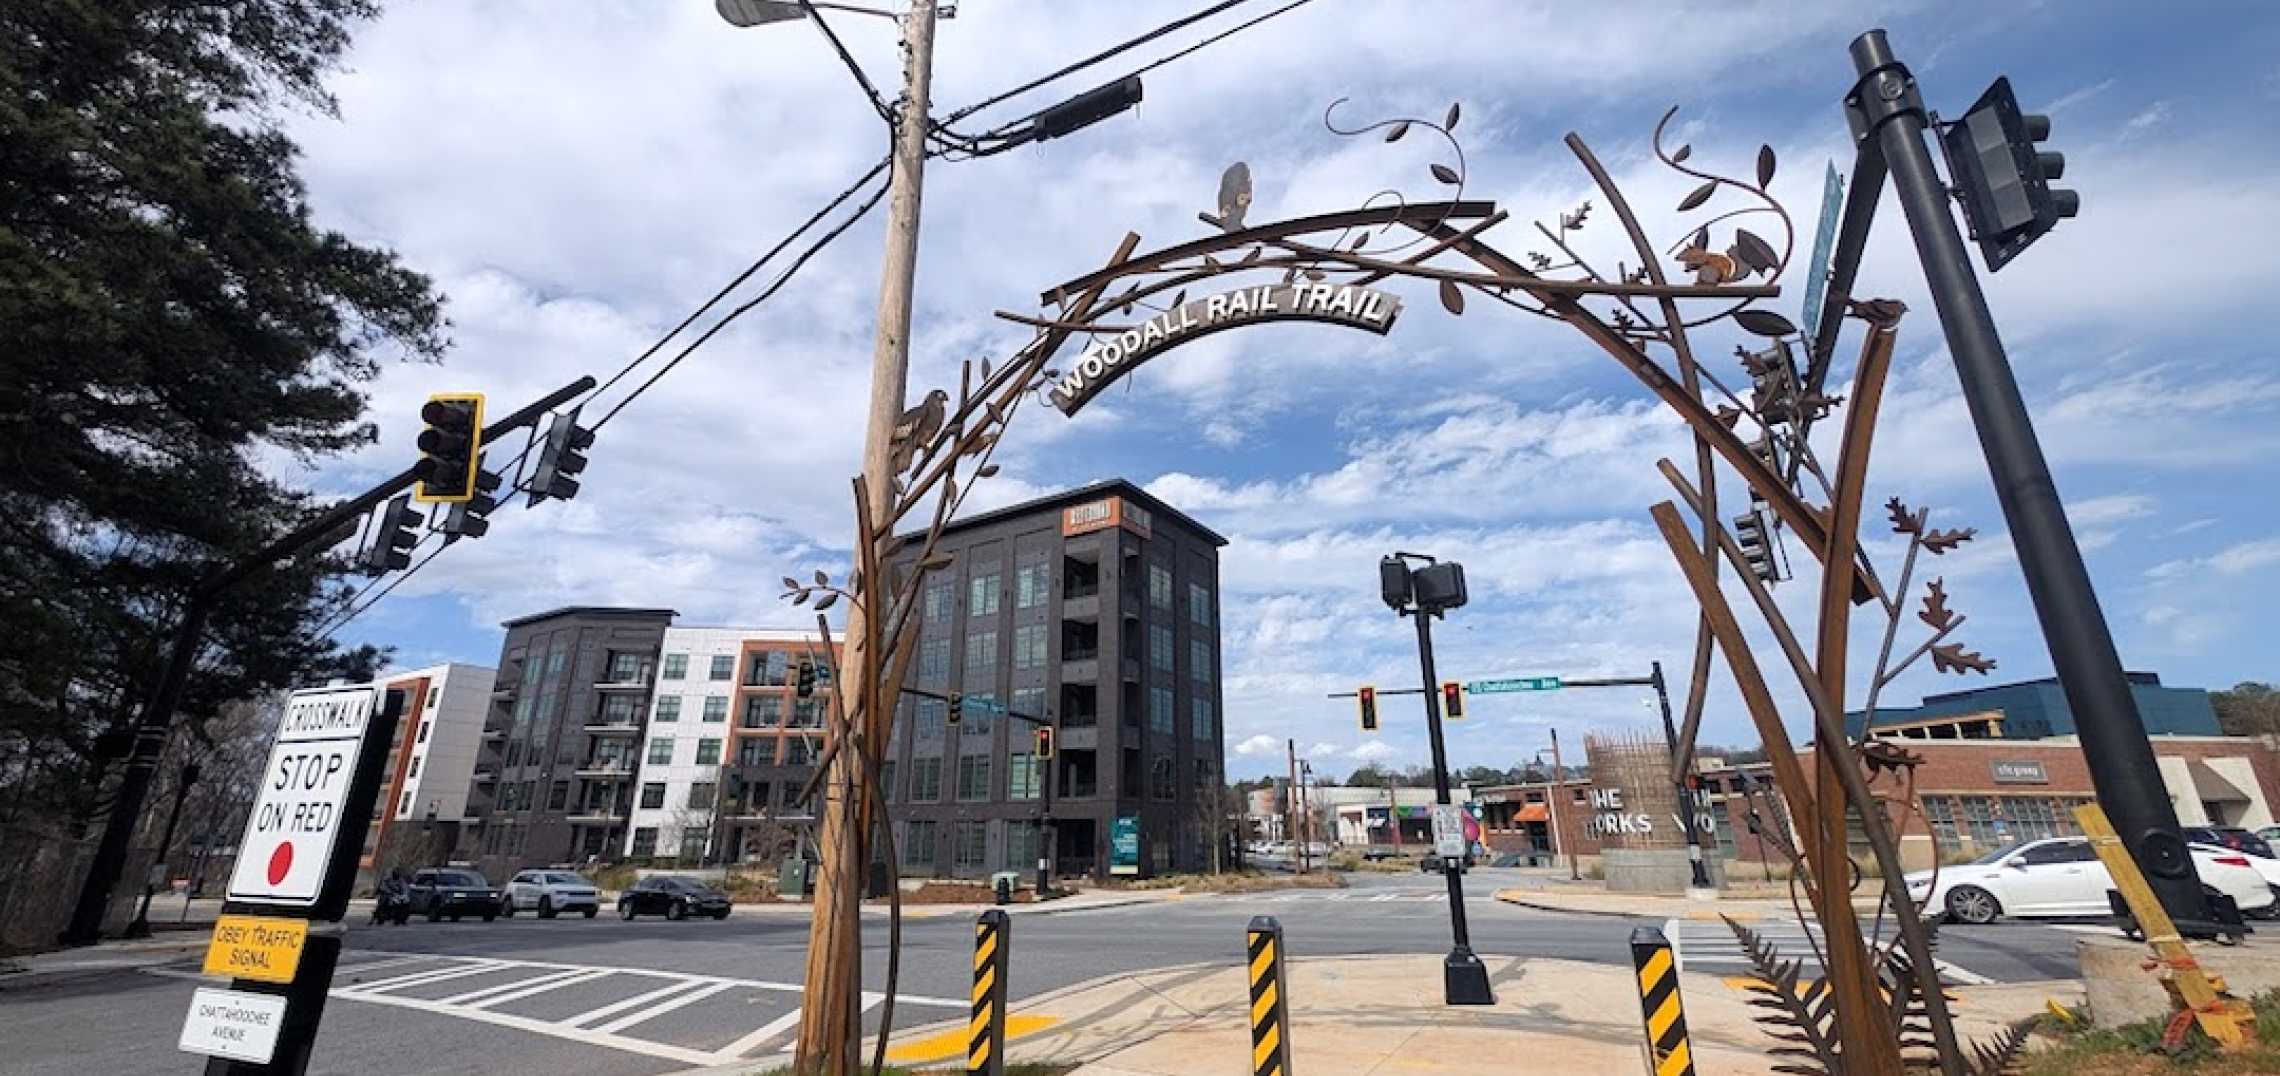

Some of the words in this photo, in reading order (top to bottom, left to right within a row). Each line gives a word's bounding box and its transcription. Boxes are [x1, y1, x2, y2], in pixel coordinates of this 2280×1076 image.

[1056, 303, 1198, 398] WOODALL
[1207, 285, 1278, 320] RAIL
[1291, 283, 1387, 320] TRAIL
[285, 699, 368, 733] CROSSWALK
[276, 753, 342, 790] STOP
[257, 802, 287, 833] ON
[290, 802, 332, 832] RED
[217, 926, 250, 944] OBEY
[251, 926, 300, 949] TRAFFIC
[229, 948, 271, 969] SIGNAL
[211, 1026, 246, 1042] AVENUE
